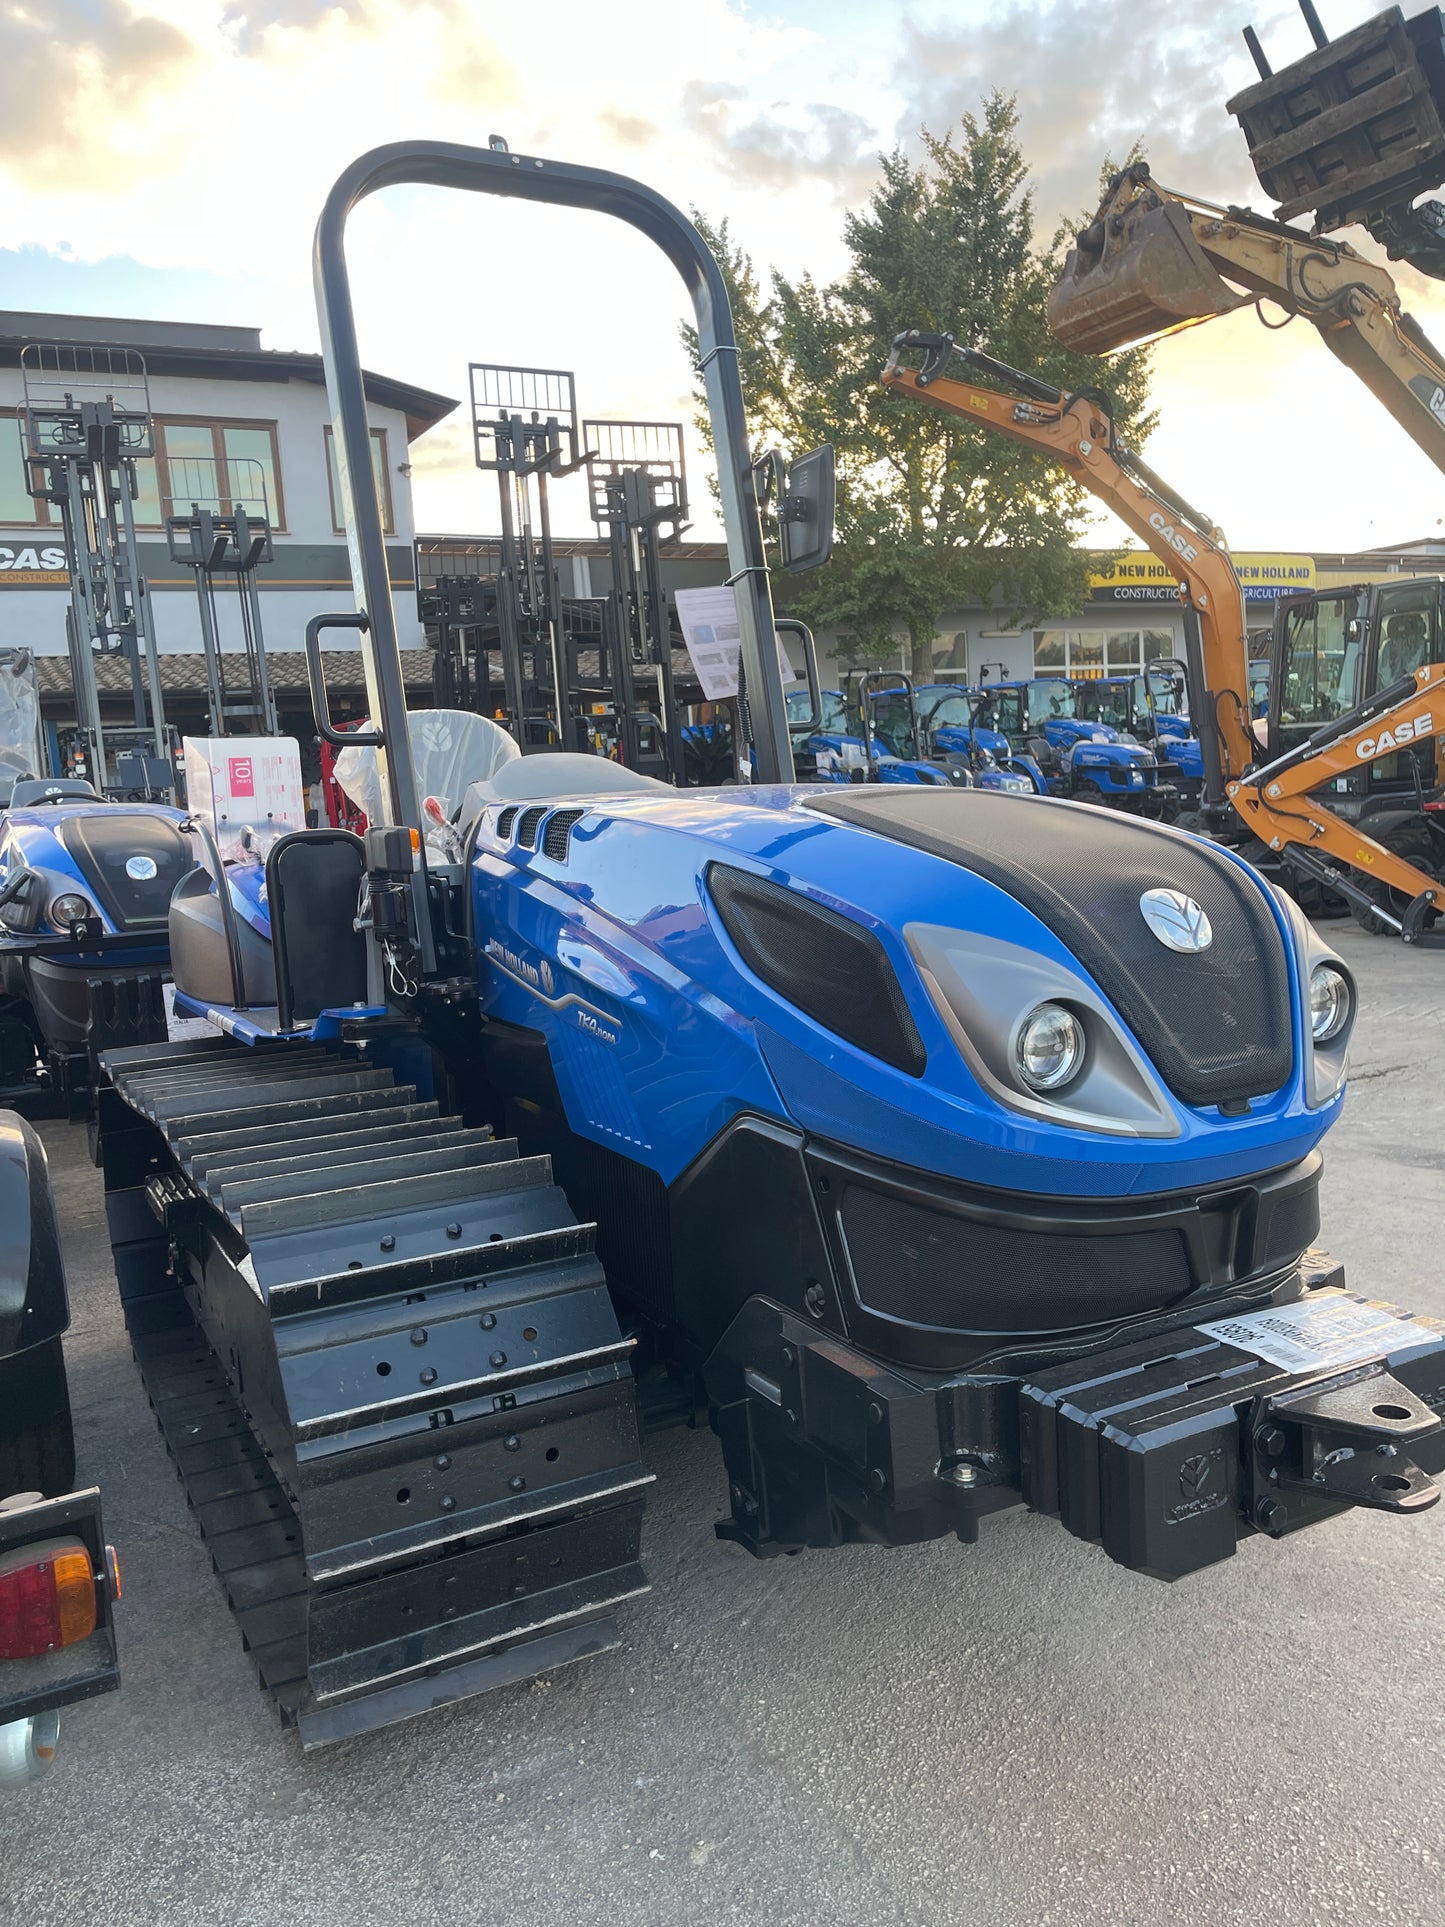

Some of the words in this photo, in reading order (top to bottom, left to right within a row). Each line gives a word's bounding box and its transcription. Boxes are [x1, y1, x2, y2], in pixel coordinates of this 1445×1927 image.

[1149, 512, 1198, 563] CASE
[0, 547, 69, 570] CAS
[1119, 565, 1146, 577] NEW
[1148, 565, 1174, 577] HOL
[1235, 566, 1260, 578] NEW
[1262, 567, 1310, 579] HOLLAND
[1356, 712, 1433, 759] CASE
[234, 760, 251, 778] 10
[504, 948, 539, 987] HOLLAND
